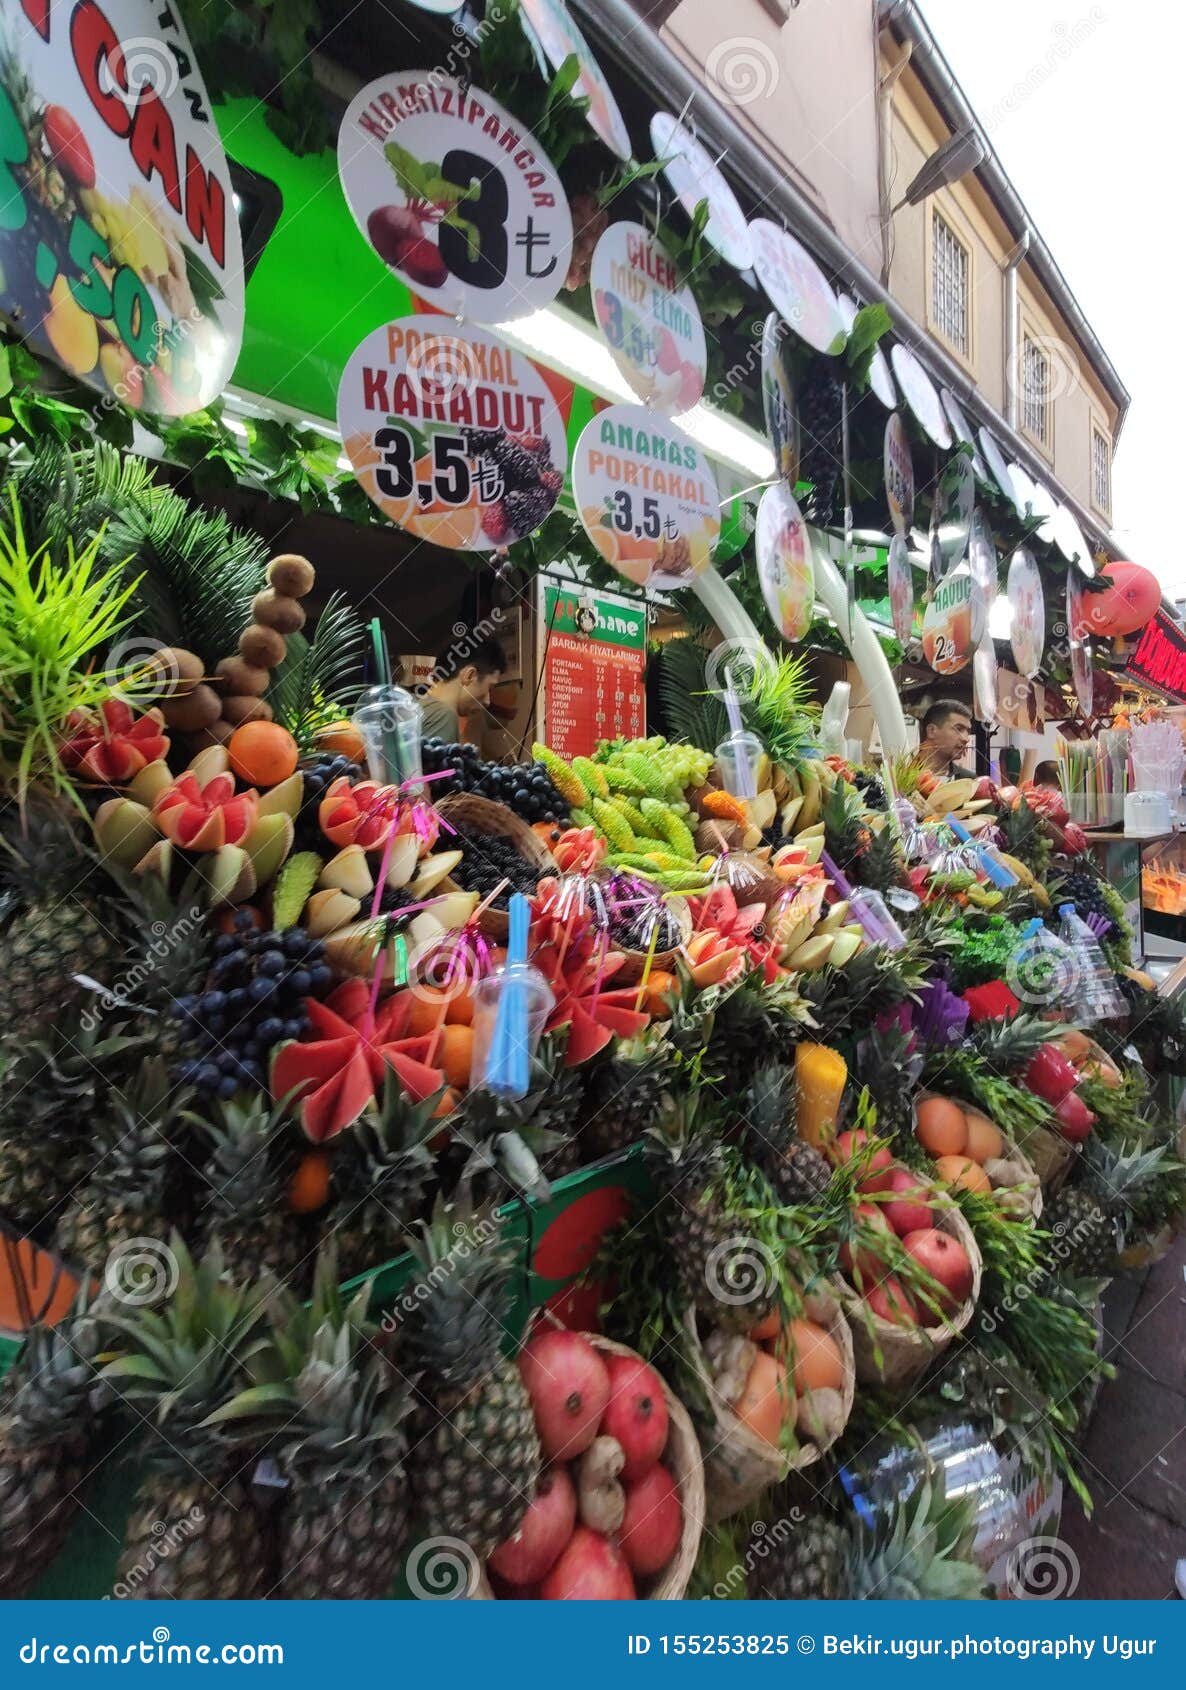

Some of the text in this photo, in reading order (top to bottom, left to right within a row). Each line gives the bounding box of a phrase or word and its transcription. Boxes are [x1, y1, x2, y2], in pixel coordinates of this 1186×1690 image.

[387, 325, 519, 387] PORTAKAL
[362, 366, 546, 436] KARADUT
[601, 419, 698, 471] ANANAS
[588, 449, 710, 507] PORTAKAL
[552, 636, 587, 654] BARDAK
[552, 658, 583, 671] PORTAKAL
[552, 667, 569, 676] ELMA
